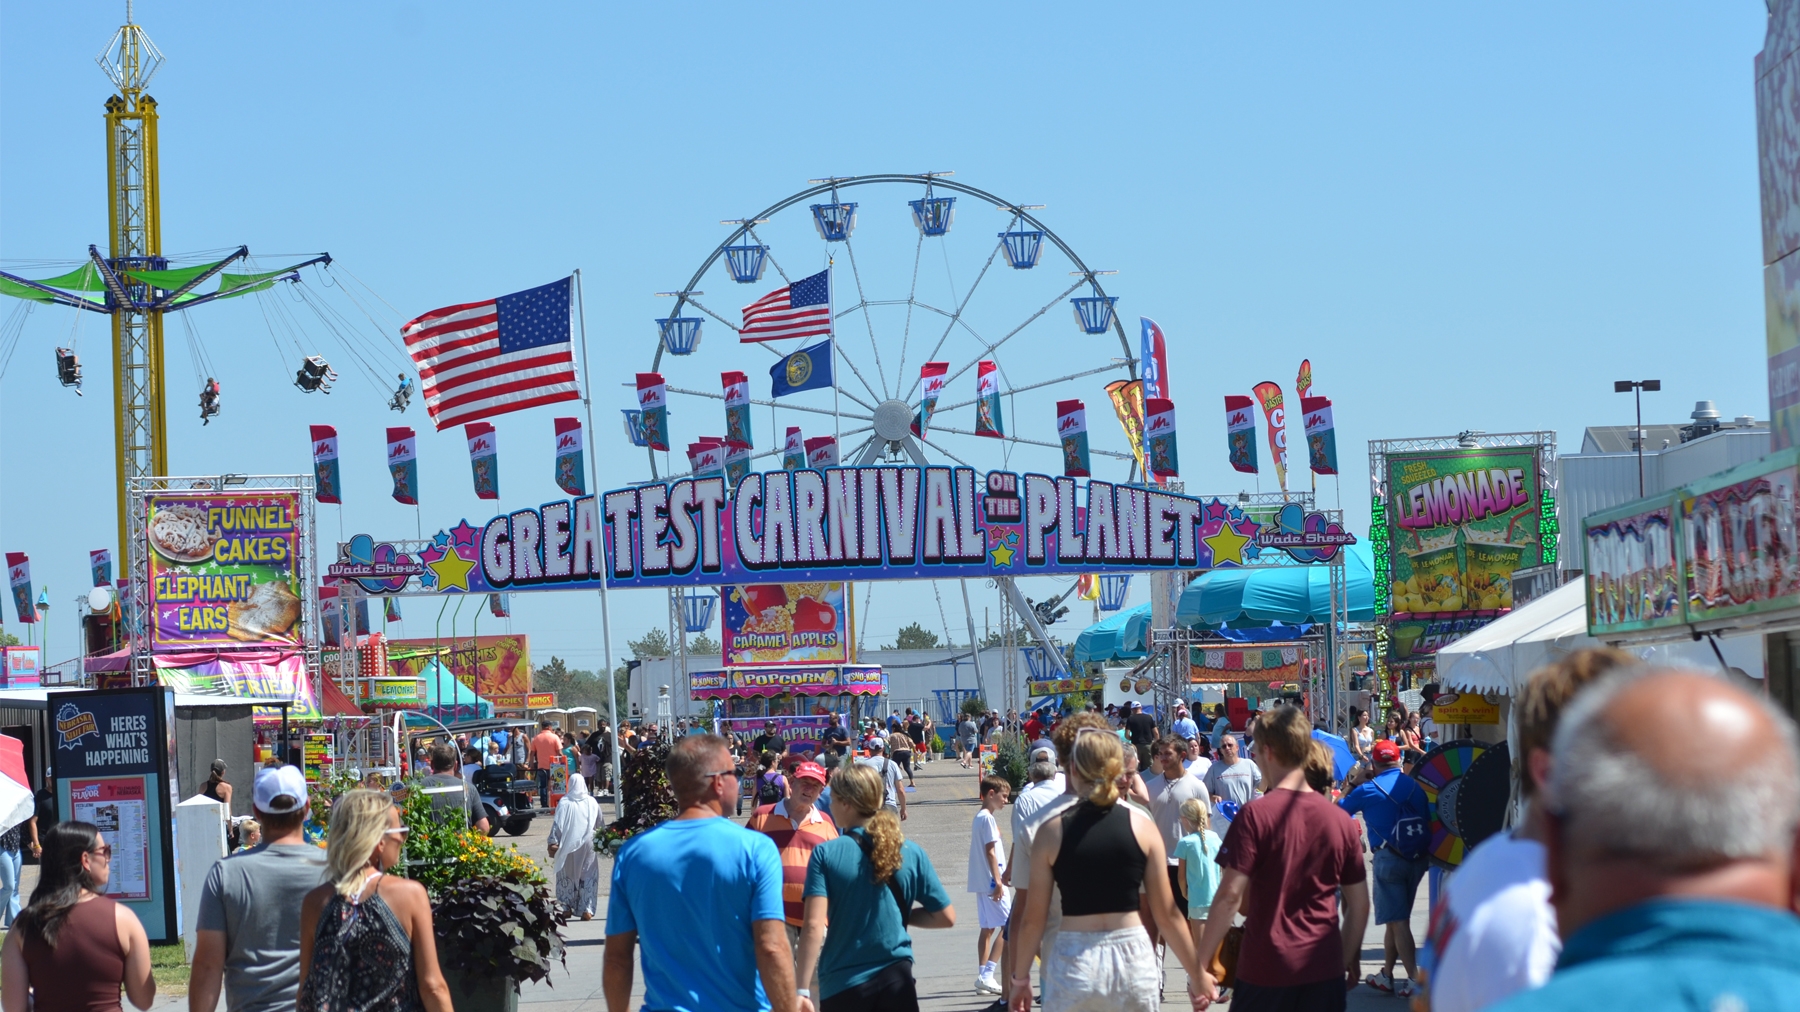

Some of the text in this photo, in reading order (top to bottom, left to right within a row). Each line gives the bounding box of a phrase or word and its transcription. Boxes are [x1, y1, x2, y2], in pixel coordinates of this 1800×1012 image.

[1403, 461, 1427, 474] FRESH
[1401, 469, 1437, 485] SQUEEZED
[1395, 468, 1529, 528] LEMONADE
[207, 506, 293, 531] FUNNEL
[482, 467, 1201, 584] GREATEST CARNIVAL ON THE PLANET
[1538, 489, 1560, 564] LEMON
[1260, 532, 1355, 545] Wade Shows
[214, 537, 287, 562] CAKES
[1369, 496, 1390, 615] LEMONADE
[1478, 552, 1519, 562] LEMONADE
[1421, 552, 1454, 568] LEMONADE
[330, 563, 426, 575] Wade Shows
[155, 575, 249, 600] ELEPHANT
[179, 606, 228, 631] EARS
[732, 631, 837, 649] CARAMEL APPLES
[232, 678, 296, 697] FRIED
[744, 672, 826, 686] POPCORN
[381, 685, 415, 695] LEMONADE
[497, 697, 523, 706] FRIES
[528, 695, 551, 705] WINGS
[58, 713, 92, 730] NEBRASKA
[110, 715, 147, 732] HERES
[65, 727, 82, 741] STATE
[105, 731, 148, 749] WHAT'S
[85, 748, 149, 767] HAPPENING
[72, 790, 100, 800] FLAVOR
